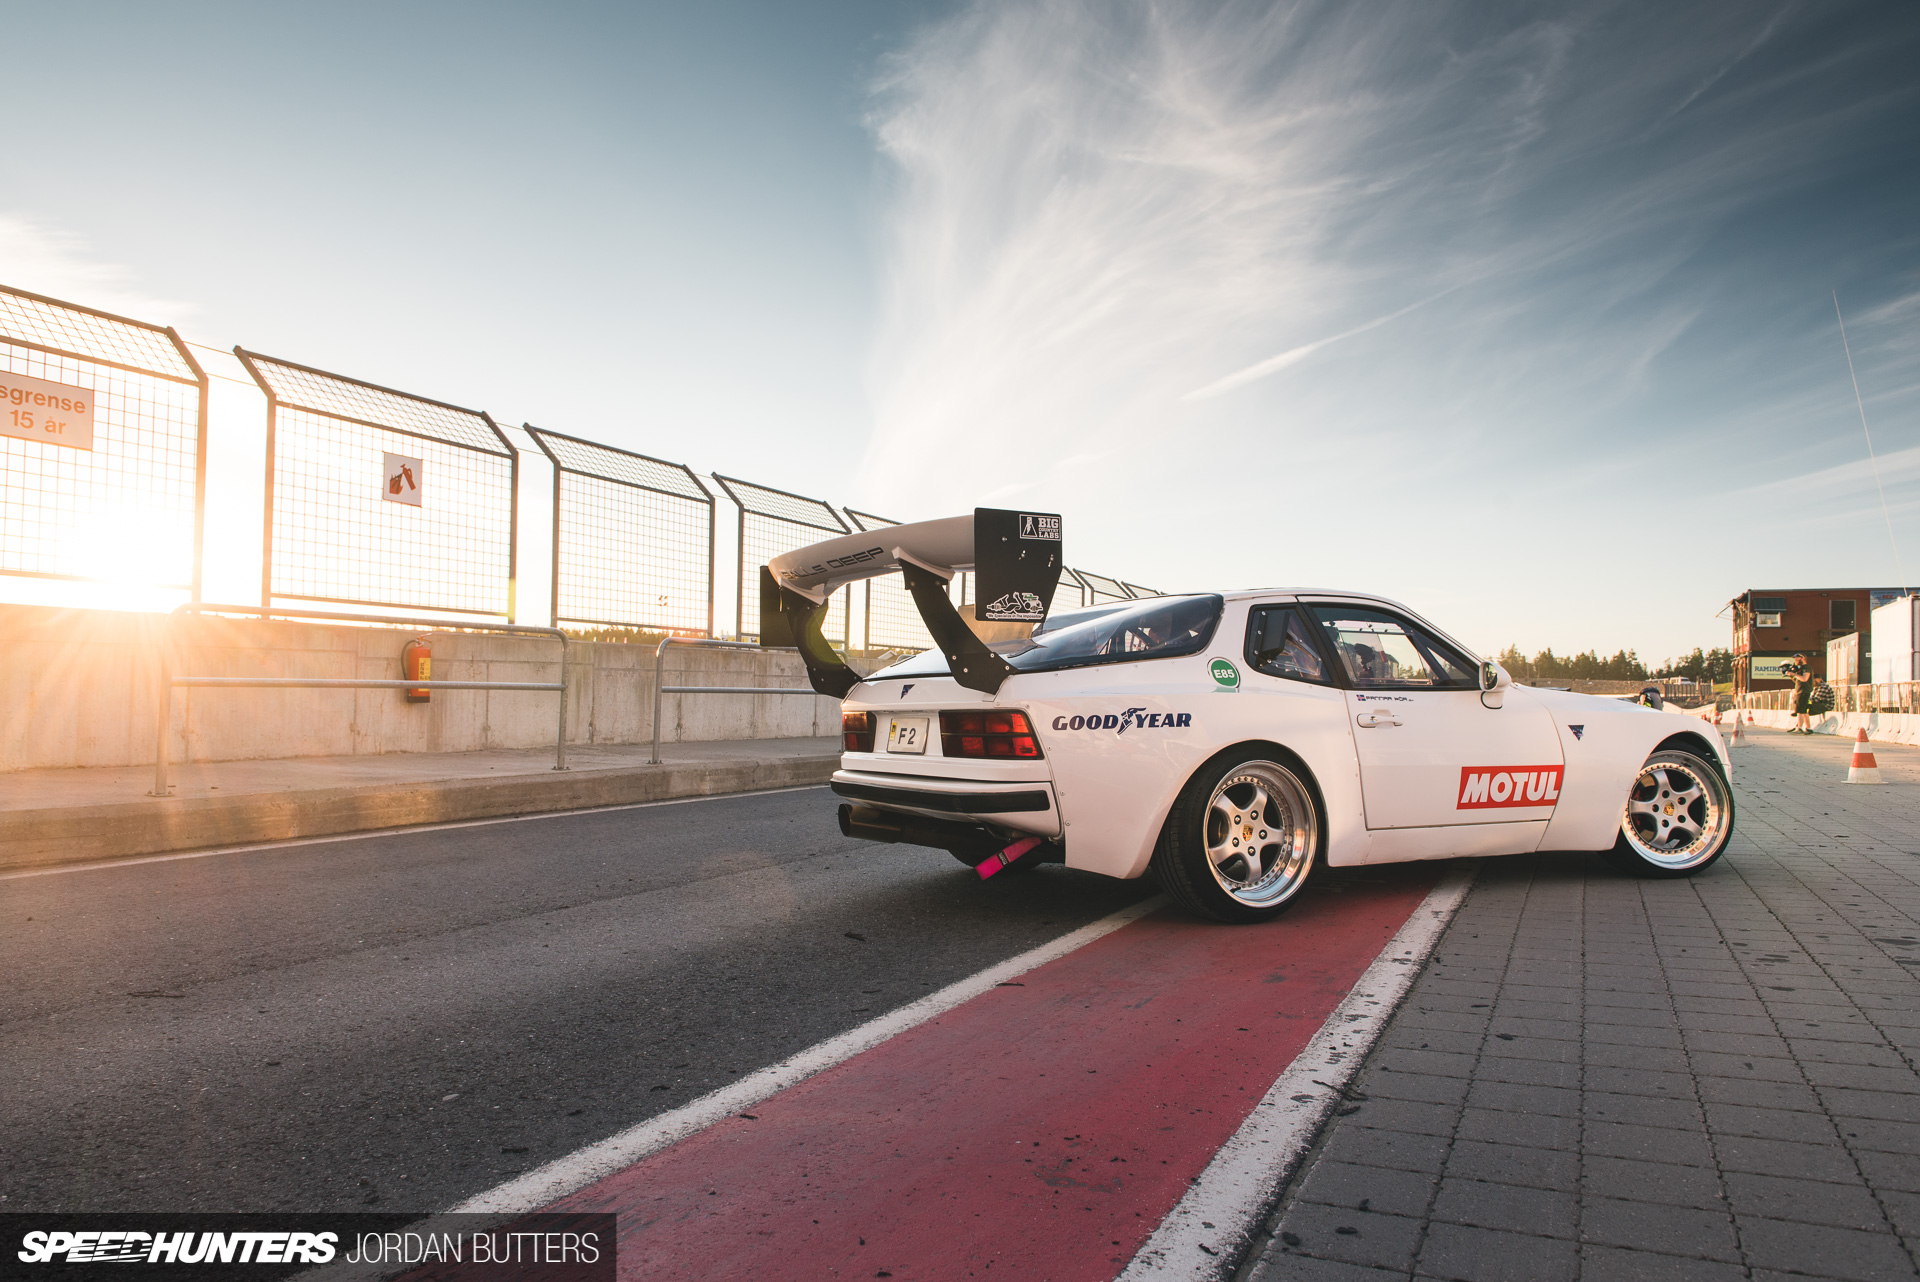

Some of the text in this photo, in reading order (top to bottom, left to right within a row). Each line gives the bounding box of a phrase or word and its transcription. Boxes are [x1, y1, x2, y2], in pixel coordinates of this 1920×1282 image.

[10, 409, 66, 434] 15 år
[1038, 517, 1059, 529] BIG
[1038, 531, 1060, 539] LABS
[826, 546, 884, 569] DEEP
[1213, 669, 1235, 679] E85
[898, 727, 917, 745] F2
[1460, 772, 1559, 804] MOTUL
